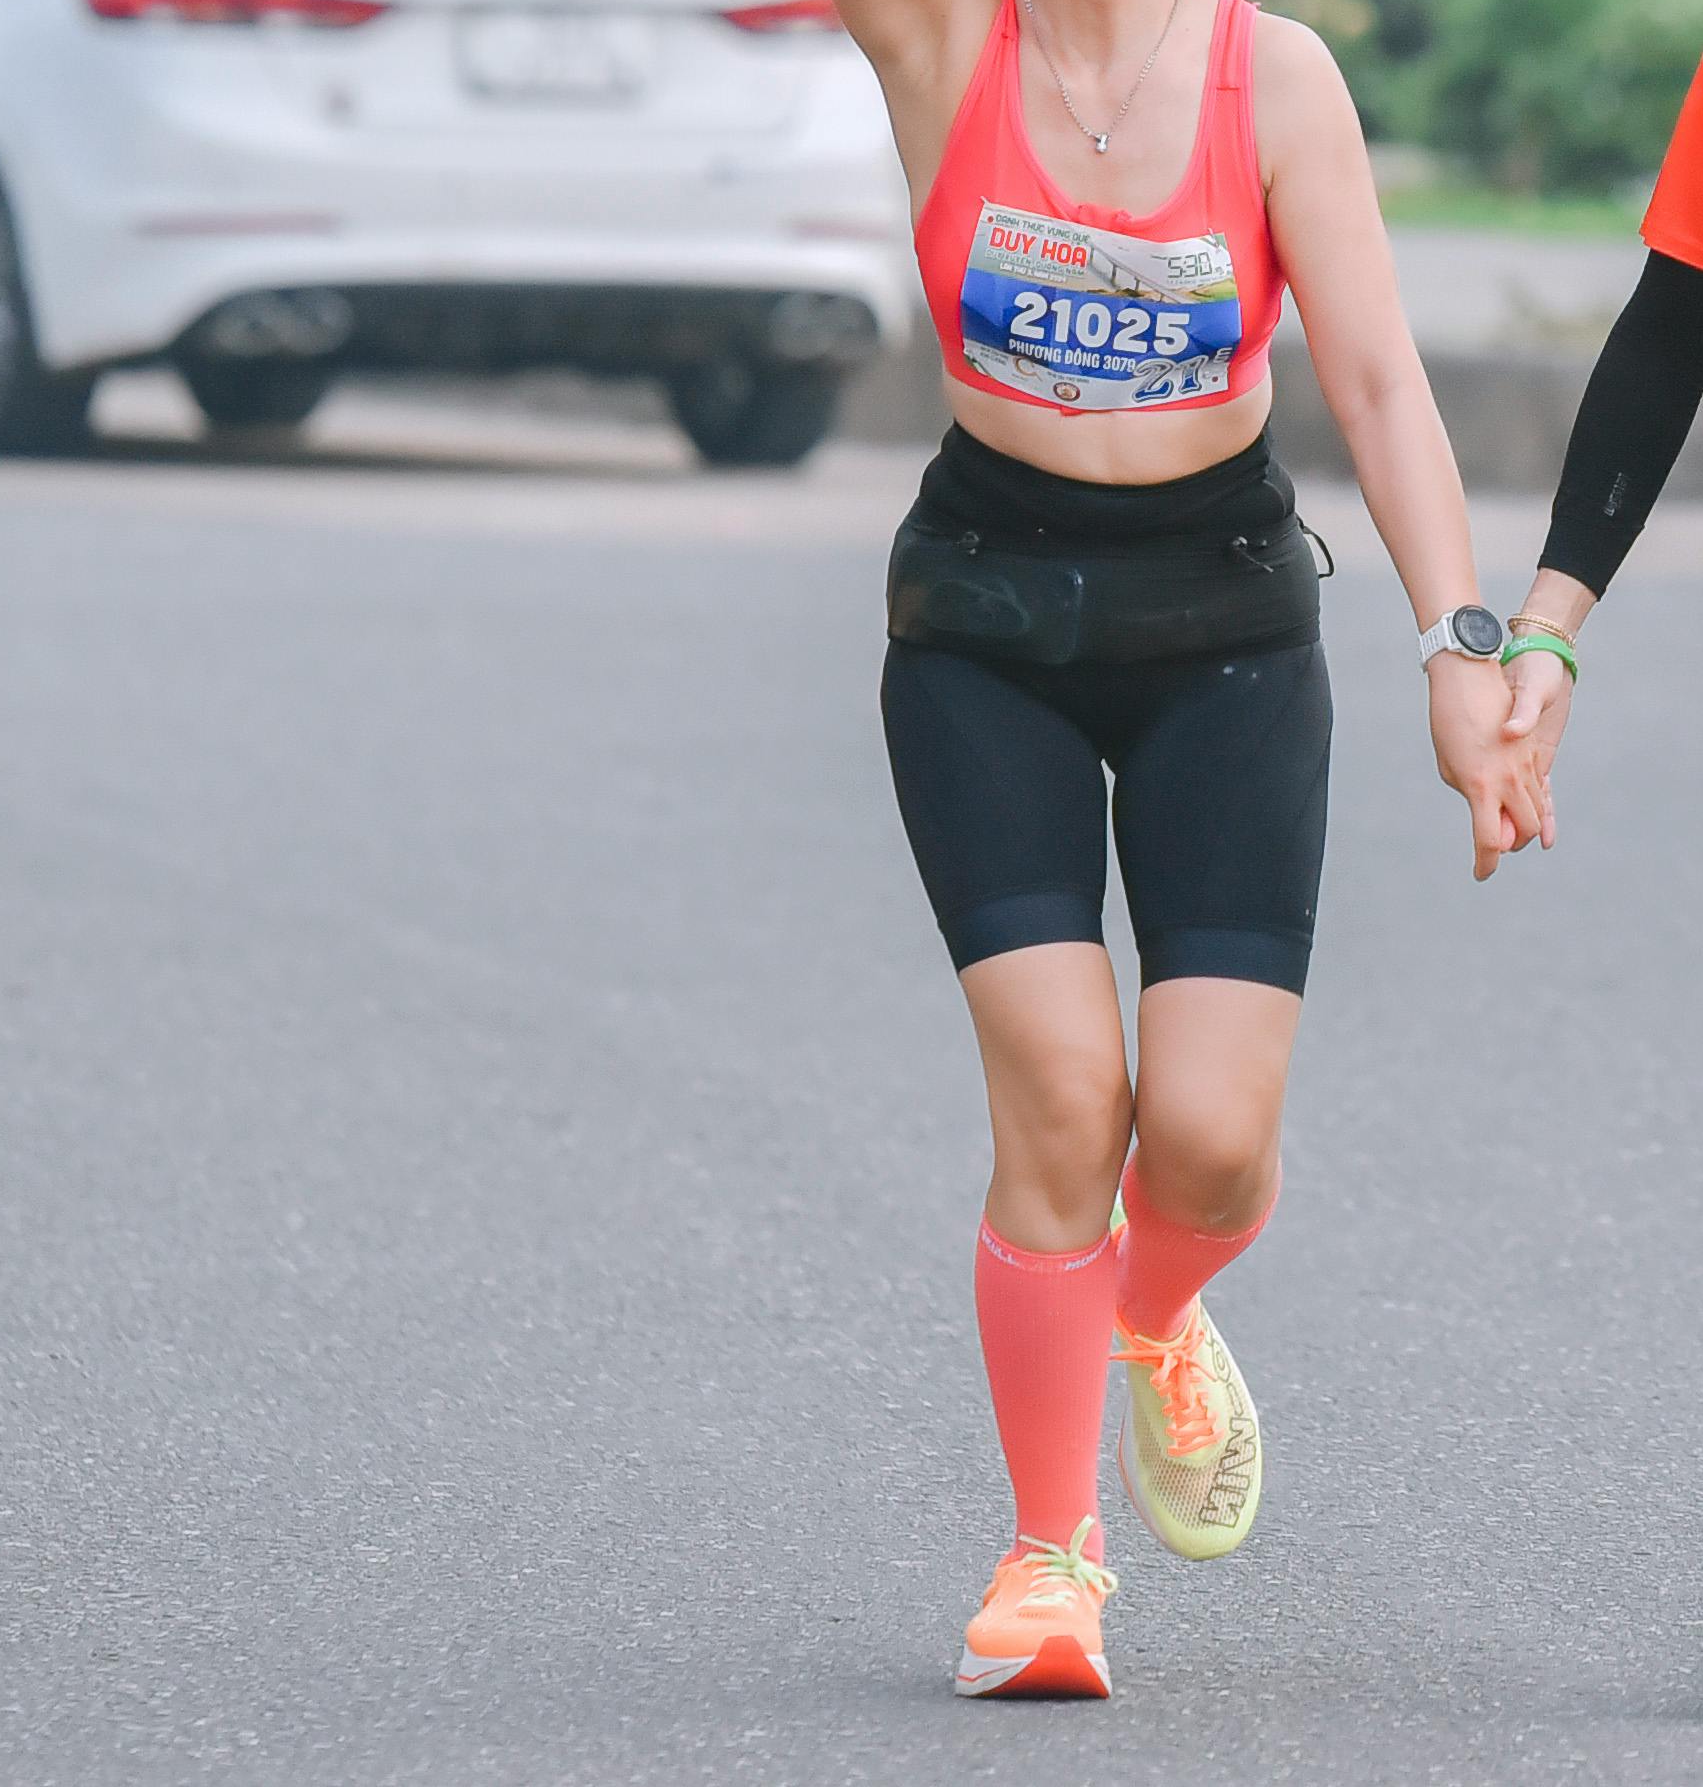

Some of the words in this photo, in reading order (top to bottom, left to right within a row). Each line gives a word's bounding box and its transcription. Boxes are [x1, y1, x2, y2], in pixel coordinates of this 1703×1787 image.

[988, 226, 1037, 256] DUY
[1010, 291, 1191, 356] 21025
[1132, 355, 1210, 404] 21
